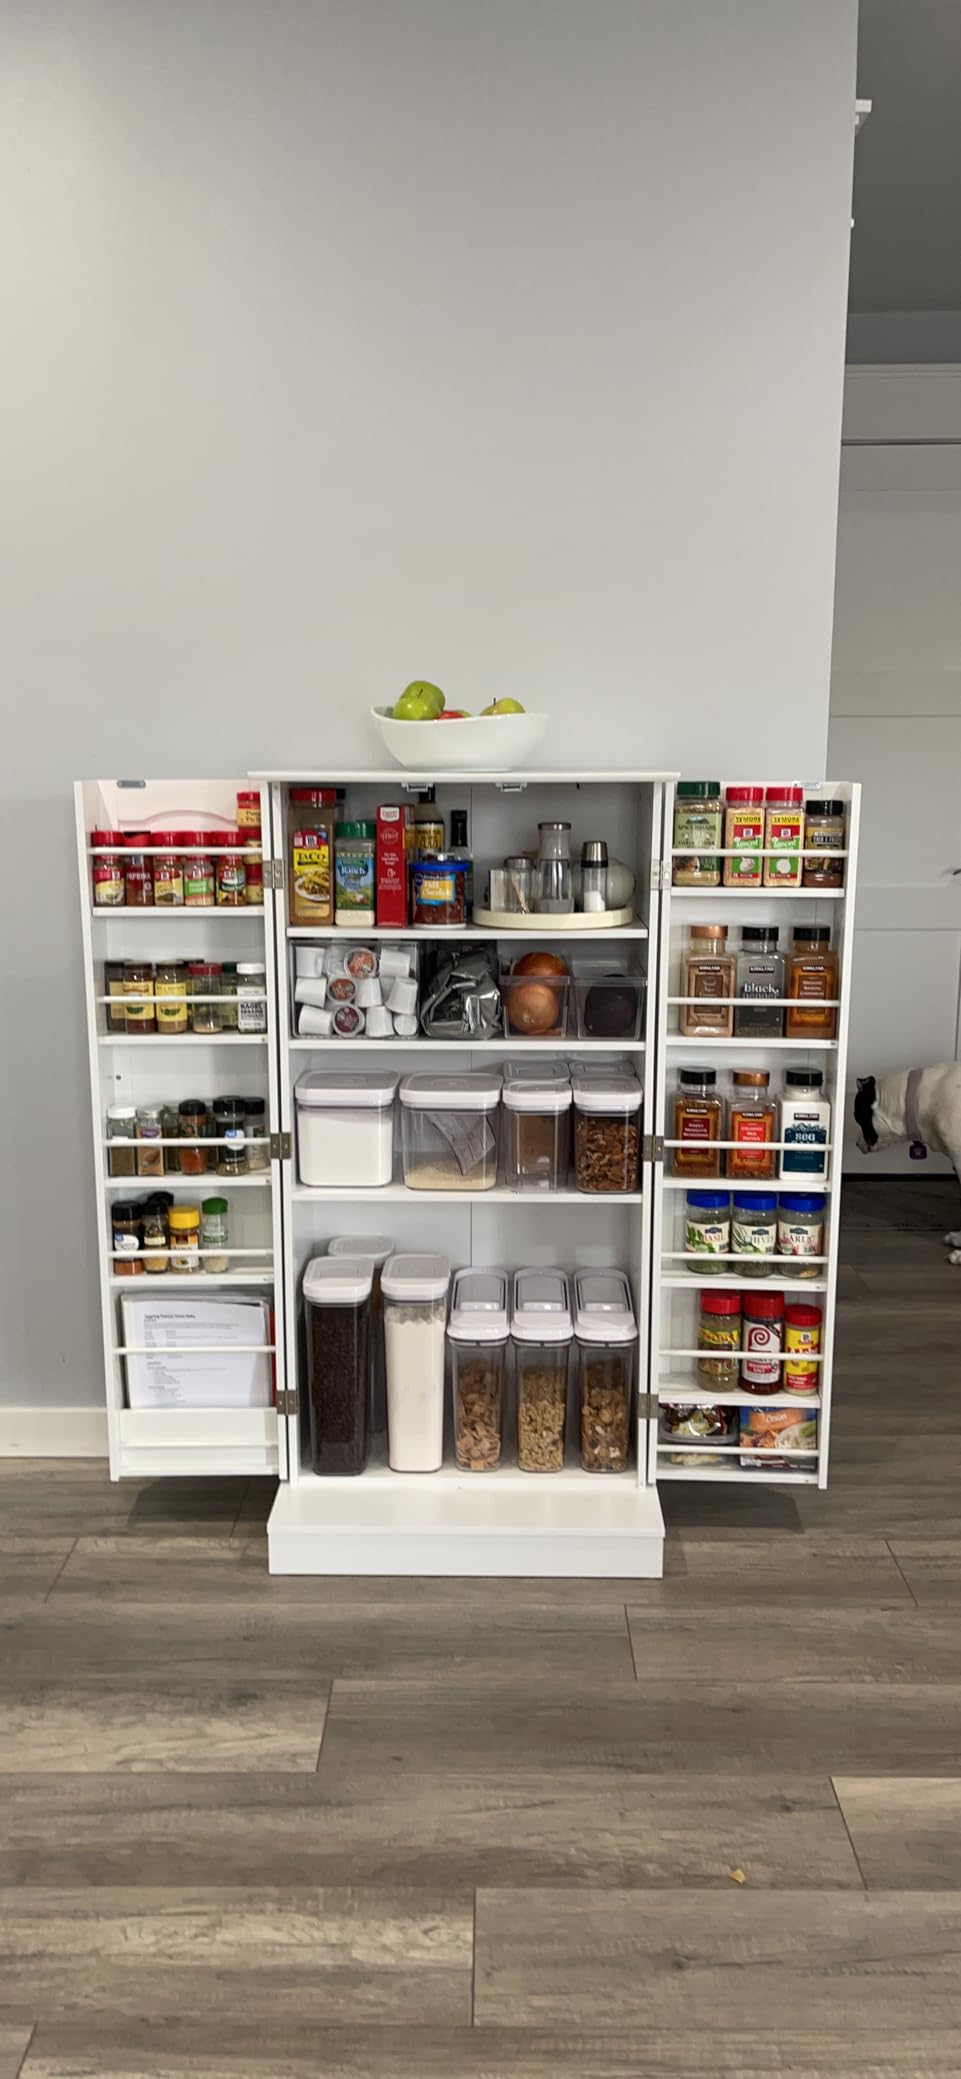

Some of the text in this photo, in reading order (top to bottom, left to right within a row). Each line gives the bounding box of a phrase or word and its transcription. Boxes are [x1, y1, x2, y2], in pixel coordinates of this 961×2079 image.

[297, 852, 326, 860] TACO
[341, 865, 366, 875] Ranch
[126, 872, 151, 880] PAPRIKA
[766, 1414, 787, 1423] Onion
